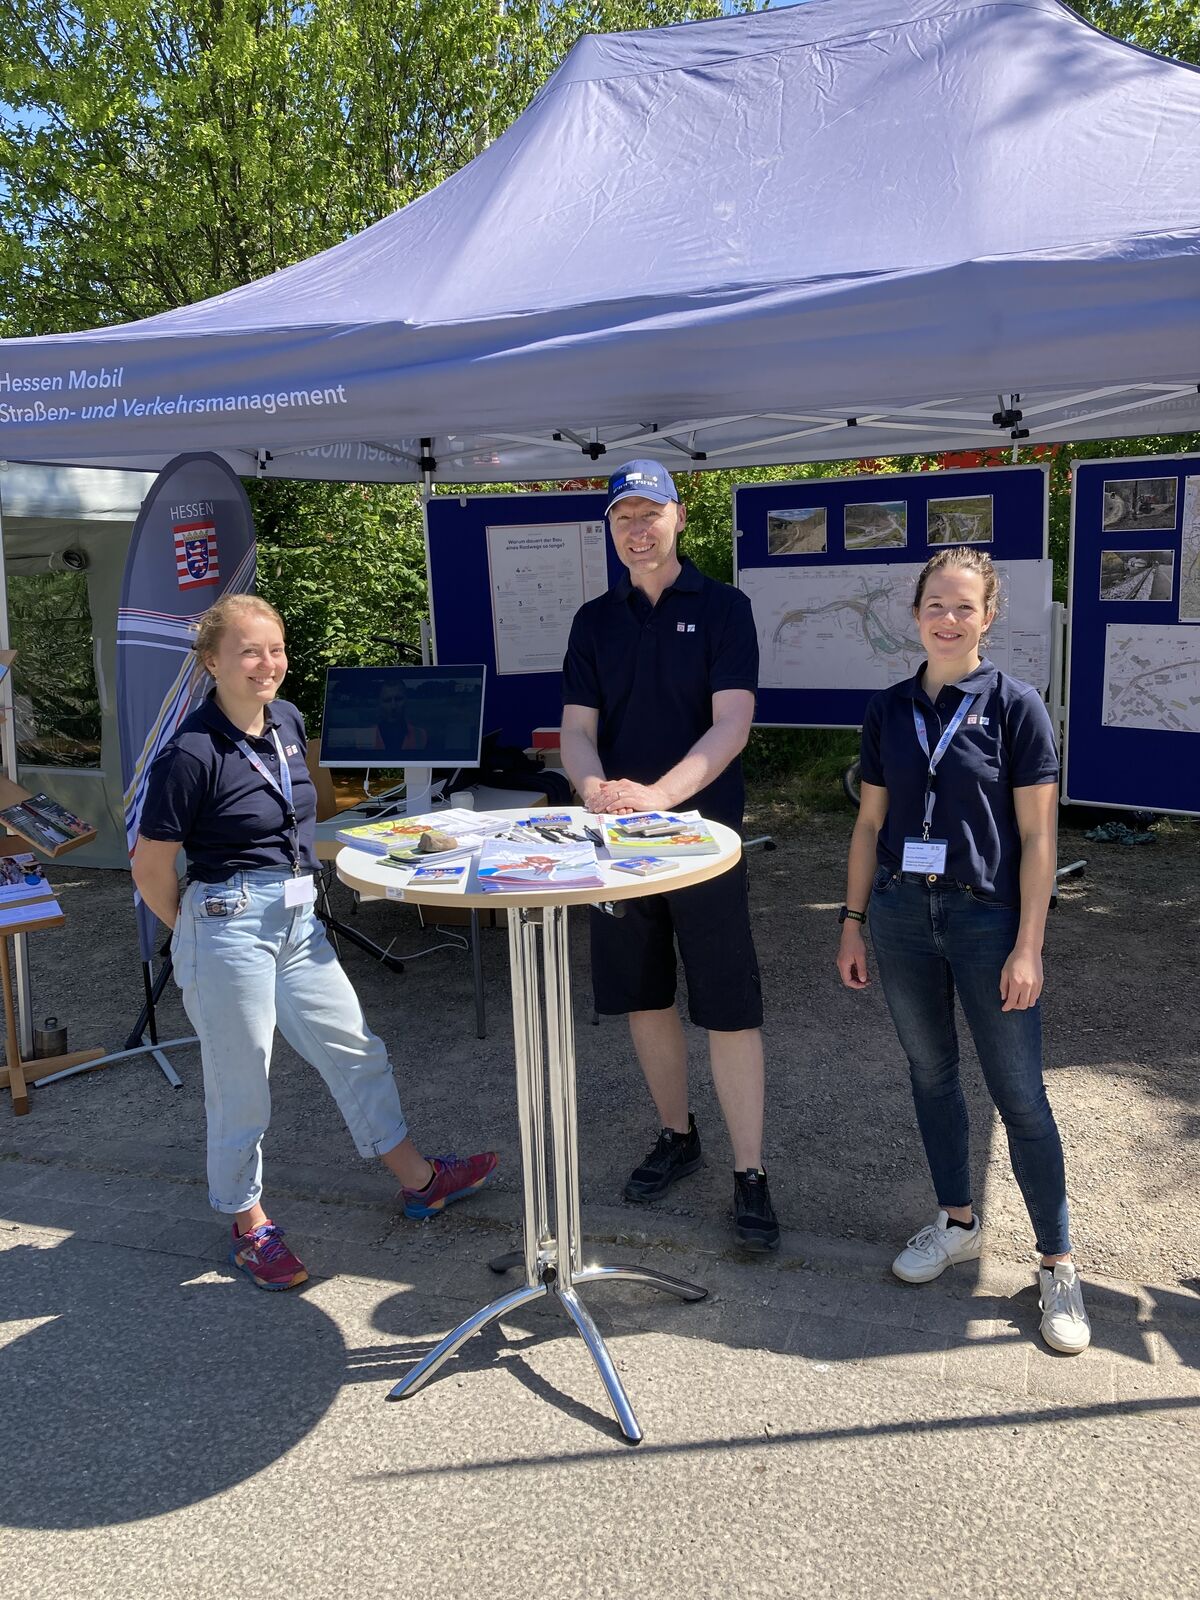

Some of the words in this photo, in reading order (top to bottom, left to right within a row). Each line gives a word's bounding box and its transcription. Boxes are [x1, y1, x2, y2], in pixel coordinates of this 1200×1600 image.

[0, 372, 62, 392] Hessen
[68, 367, 124, 389] Mobil
[0, 400, 76, 423] Straßen-
[81, 398, 117, 419] und
[122, 384, 347, 417] Verkehrsmanagement
[170, 502, 214, 520] HESSEN
